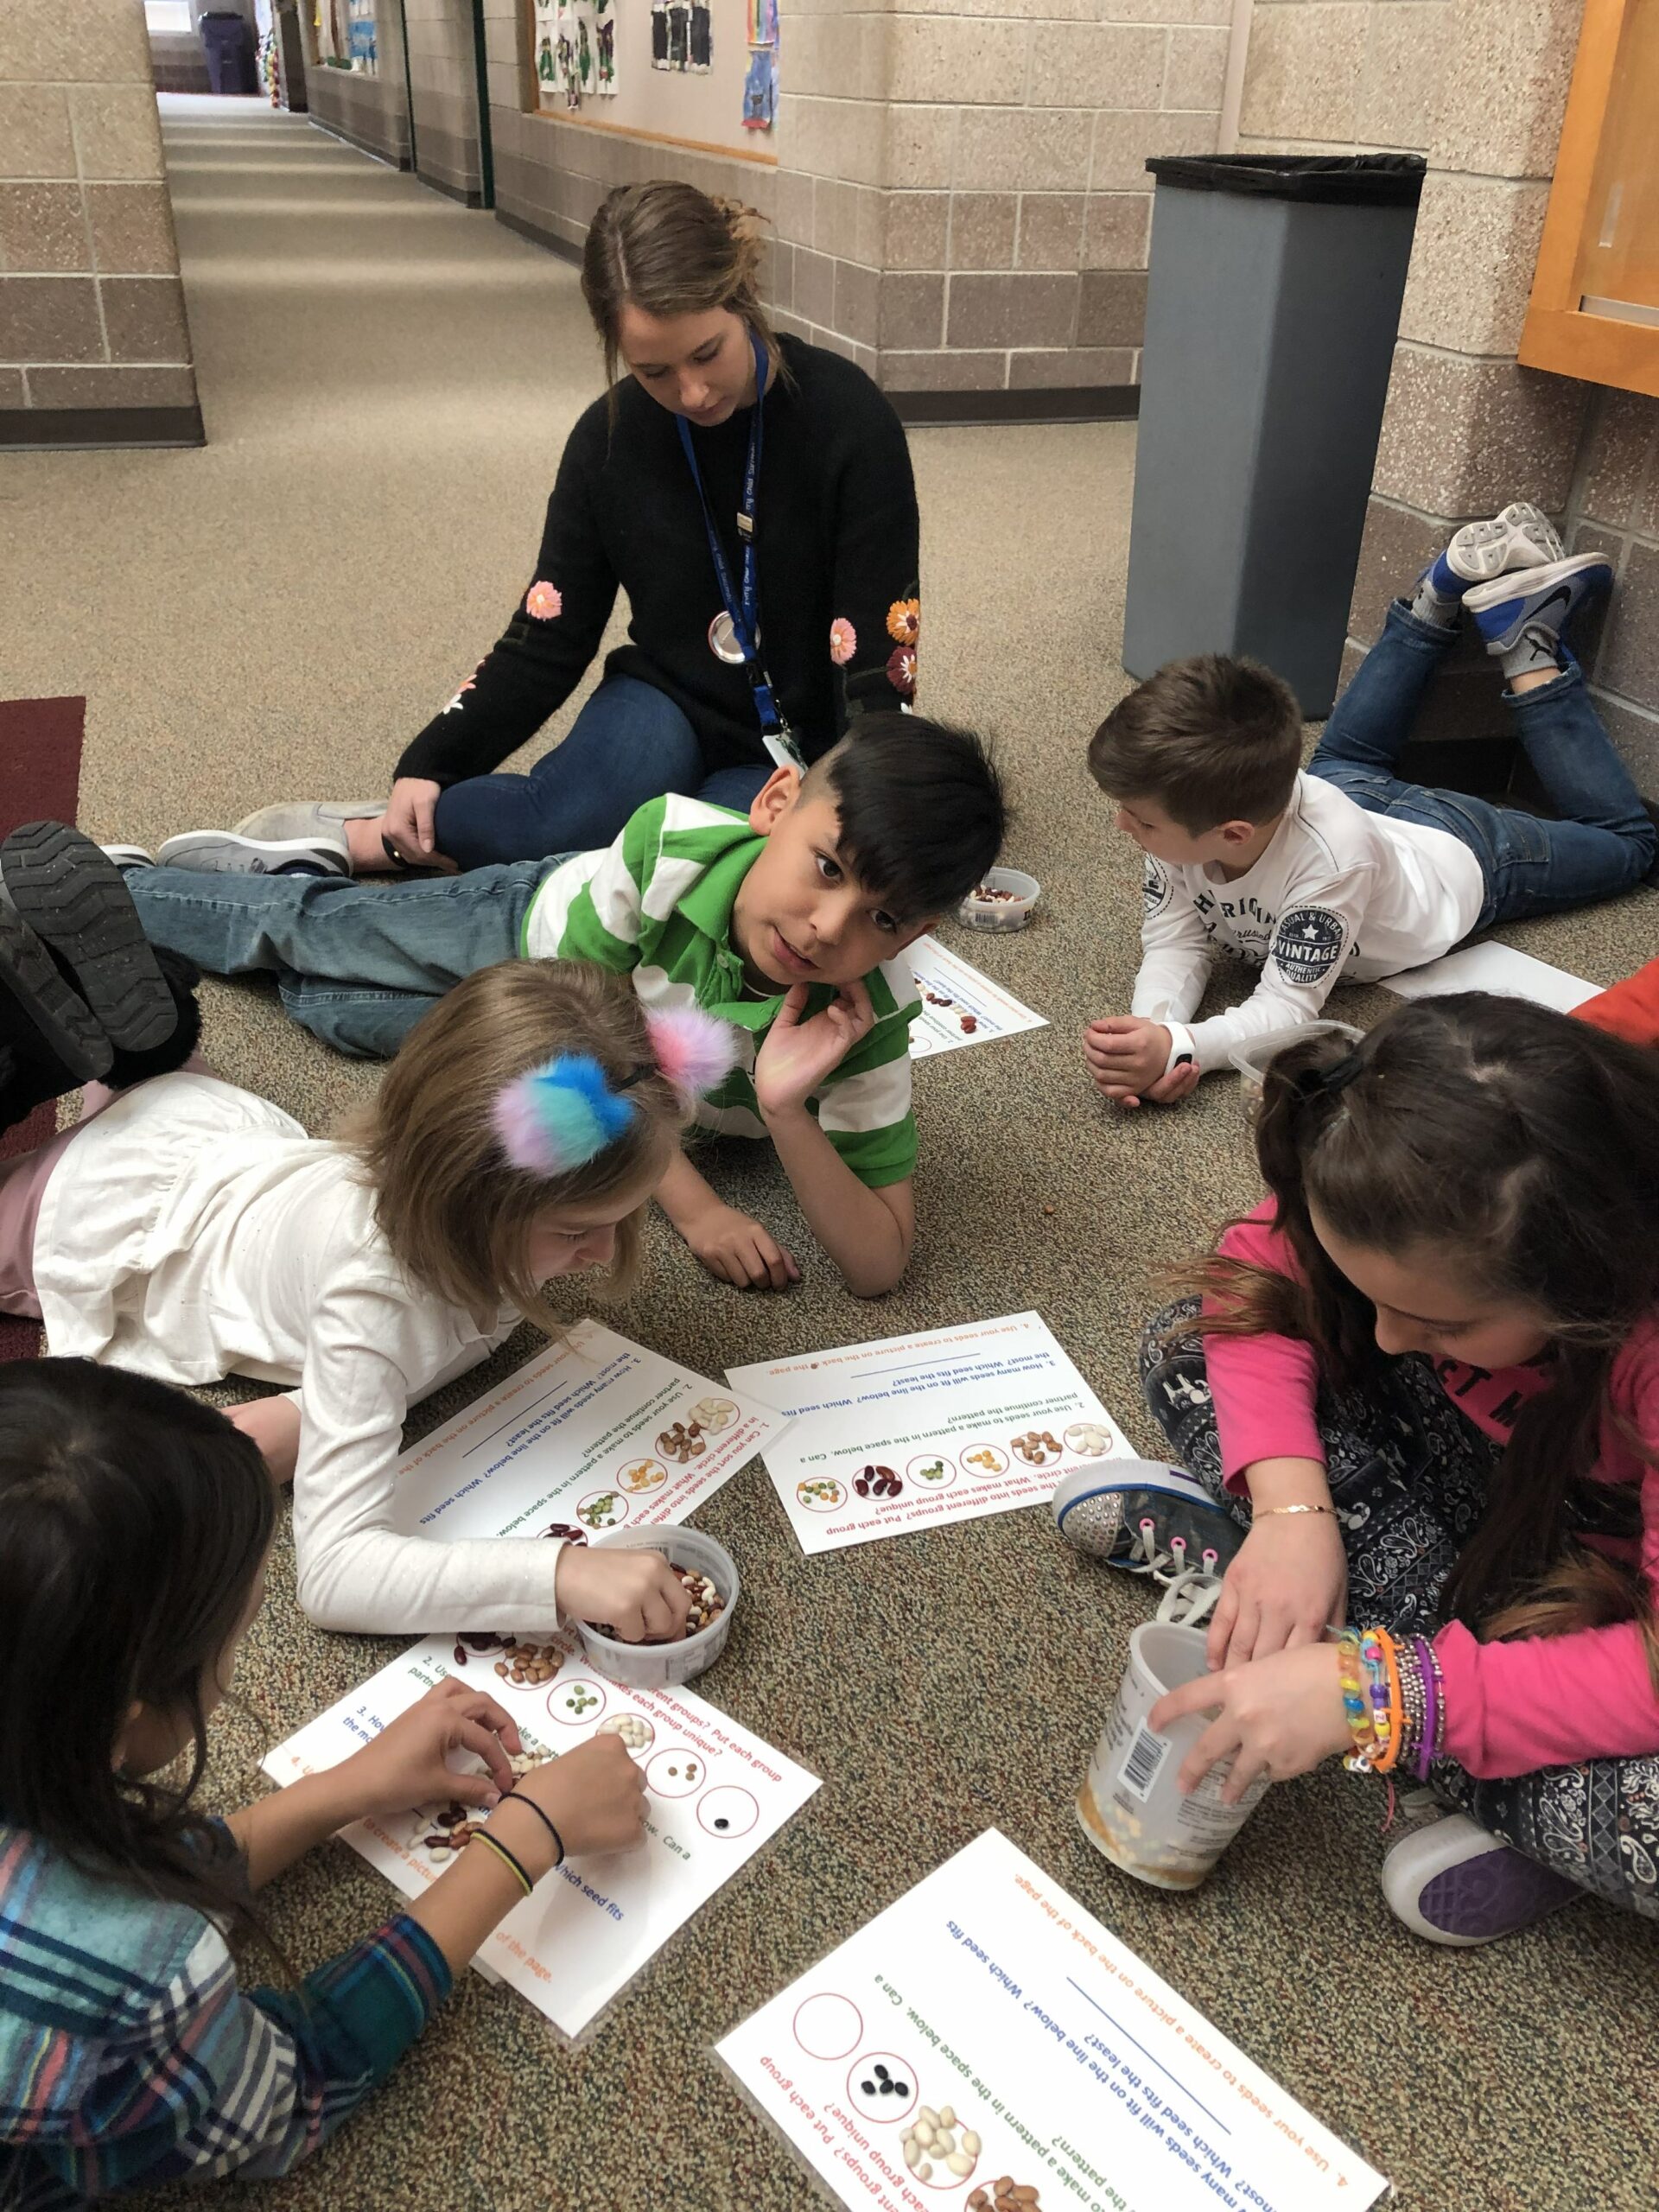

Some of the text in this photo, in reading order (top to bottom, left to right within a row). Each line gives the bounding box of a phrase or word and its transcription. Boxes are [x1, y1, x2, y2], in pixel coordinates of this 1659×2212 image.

[1308, 912, 1316, 921] &
[1279, 940, 1338, 962] VINTAGE
[1285, 963, 1321, 975] AUTHENTIC
[1286, 969, 1319, 982] QUALITY
[614, 1351, 631, 1363] the
[1007, 1354, 1033, 1366] most?
[1033, 1351, 1050, 1359] the
[613, 1364, 632, 1379] How
[951, 1365, 974, 1376] seed
[973, 1360, 1004, 1371] Which
[995, 1366, 1021, 1376] many
[1021, 1362, 1044, 1370] How
[935, 1369, 951, 1377] fits
[969, 1370, 995, 1381] seeds
[592, 1376, 615, 1394] many
[892, 1375, 919, 1387] least?
[950, 1376, 969, 1385] will
[569, 1379, 597, 1397] Which
[653, 1376, 681, 1400] partner
[890, 1387, 909, 1395] line
[552, 1395, 572, 1411] seed
[572, 1391, 595, 1408] seeds
[821, 1398, 853, 1409] Which
[855, 1390, 891, 1403] below?
[539, 1408, 556, 1420] fits
[558, 1407, 575, 1420] will
[623, 1398, 656, 1423] continue
[797, 1403, 821, 1414] seed
[946, 1391, 1078, 1424] partner continue the pattern?
[1032, 1406, 1053, 1417] your
[1052, 1403, 1072, 1412] Use
[525, 1417, 543, 1429] the
[549, 1416, 563, 1426] fit
[964, 1419, 992, 1429] make
[1003, 1412, 1031, 1422] seeds
[610, 1421, 627, 1433] the
[921, 1424, 957, 1438] pattern
[524, 1432, 542, 1445] the
[863, 1438, 892, 1450] space
[893, 1435, 911, 1444] the
[510, 1442, 529, 1456] line
[830, 1445, 864, 1457] below.
[807, 1452, 827, 1462] Can
[453, 1478, 484, 1498] Which
[969, 1481, 1002, 1493] makes
[1002, 1476, 1032, 1487] What
[914, 1491, 945, 1505] group
[944, 1488, 969, 1499] each
[433, 1496, 455, 1515] seed
[825, 1481, 1060, 1535] the seeds into different groups? Put each group
[418, 1511, 436, 1525] fits
[631, 1693, 655, 1712] each
[652, 1708, 683, 1731] group
[681, 1728, 723, 1757] unique?
[669, 1701, 782, 1782] groups? Put each group
[661, 1834, 683, 1854] Can
[1014, 1872, 1043, 1901] page.
[580, 1884, 609, 1907] seed
[605, 1901, 624, 1921] fits
[1039, 1899, 1059, 1920] the
[1055, 1916, 1072, 1930] of
[1070, 1928, 1098, 1956] back
[506, 1939, 527, 1960] the
[523, 1956, 552, 1984] page.
[1097, 1953, 1117, 1974] the
[1117, 1971, 1135, 1988] on
[1133, 1986, 1178, 2026] picture
[1174, 2024, 1185, 2035] a
[1083, 2033, 1122, 2069] least?
[1183, 2033, 1223, 2070] create
[945, 1919, 1237, 2209] many seeds will fit on the line below? Which seed fits
[1120, 2064, 1142, 2088] the
[1221, 2069, 1237, 2086] to
[874, 1974, 1091, 2203] make a pattern in the space below. Can a
[1141, 2085, 1163, 2109] fits
[1236, 2082, 1273, 2119] seeds
[759, 2056, 882, 2195] groups? Put each group
[1159, 2105, 1193, 2137] seed
[1272, 2119, 1305, 2147] your
[823, 2101, 906, 2188] group unique?
[1192, 2134, 1232, 2178] Which
[1303, 2145, 1329, 2172] Use
[1051, 2135, 1127, 2212] the pattern?
